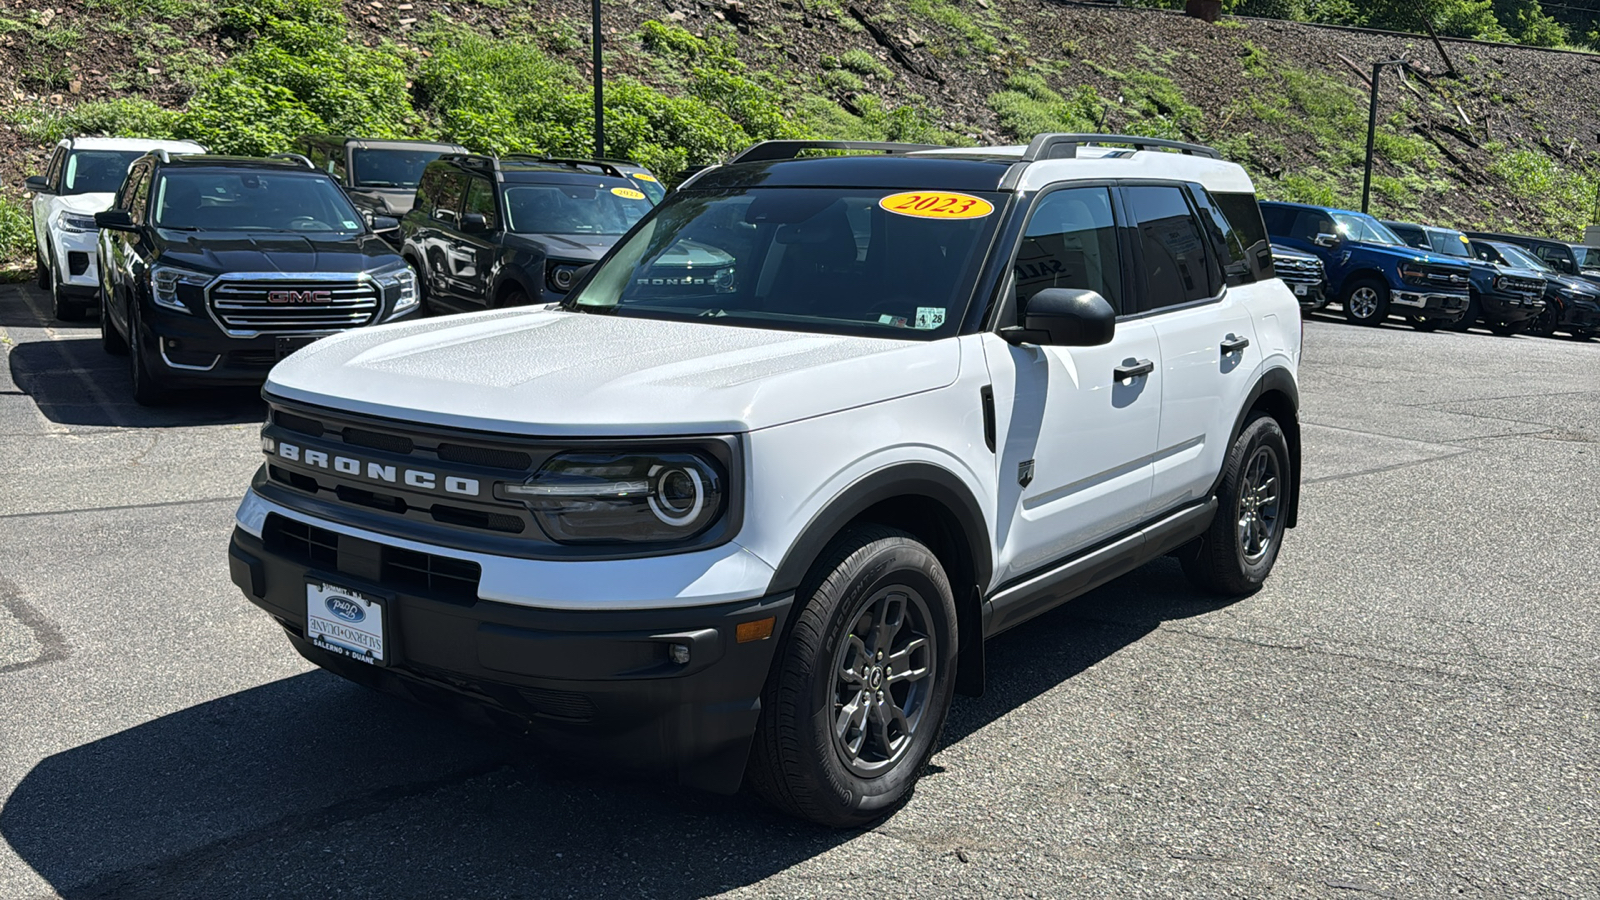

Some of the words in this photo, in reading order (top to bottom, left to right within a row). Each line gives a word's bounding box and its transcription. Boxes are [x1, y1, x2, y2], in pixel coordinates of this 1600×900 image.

[894, 195, 977, 214] 2023
[637, 278, 705, 286] RONCO
[268, 290, 332, 304] GMC
[919, 314, 926, 324] 4
[932, 314, 943, 324] 28
[279, 442, 480, 497] BRONCO
[333, 599, 358, 620] Ford
[310, 618, 340, 637] DUANE
[344, 629, 382, 650] SALERNO
[313, 639, 343, 654] SALERNO
[352, 651, 375, 665] DUANE
